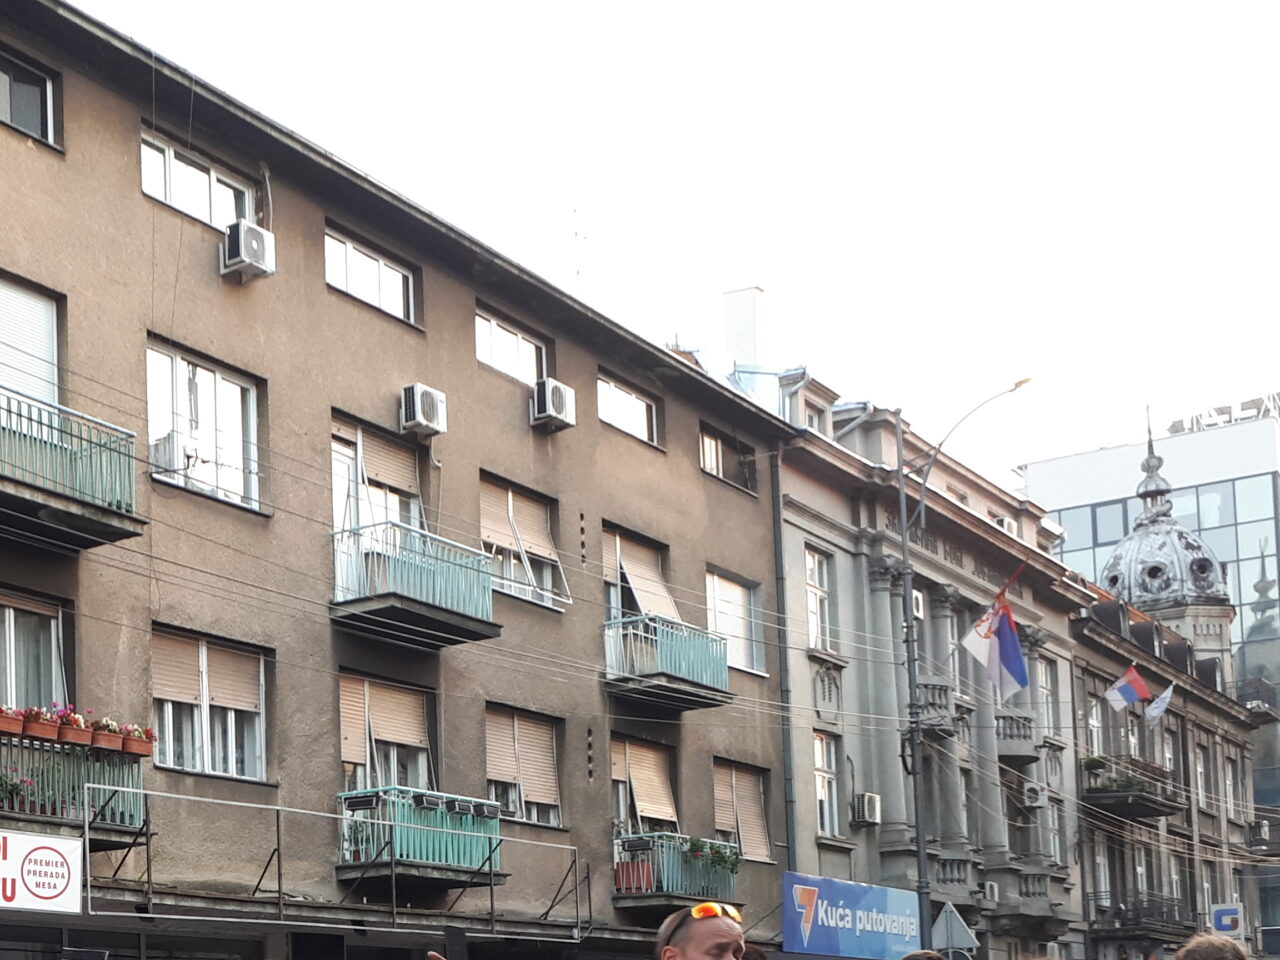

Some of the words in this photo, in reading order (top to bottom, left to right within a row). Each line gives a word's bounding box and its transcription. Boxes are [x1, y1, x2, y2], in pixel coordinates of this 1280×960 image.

[28, 858, 65, 869] PREMIER
[27, 869, 66, 880] PRERADA
[35, 881, 57, 891] MESA
[817, 898, 852, 930] Kuća
[856, 908, 918, 942] putovanja
